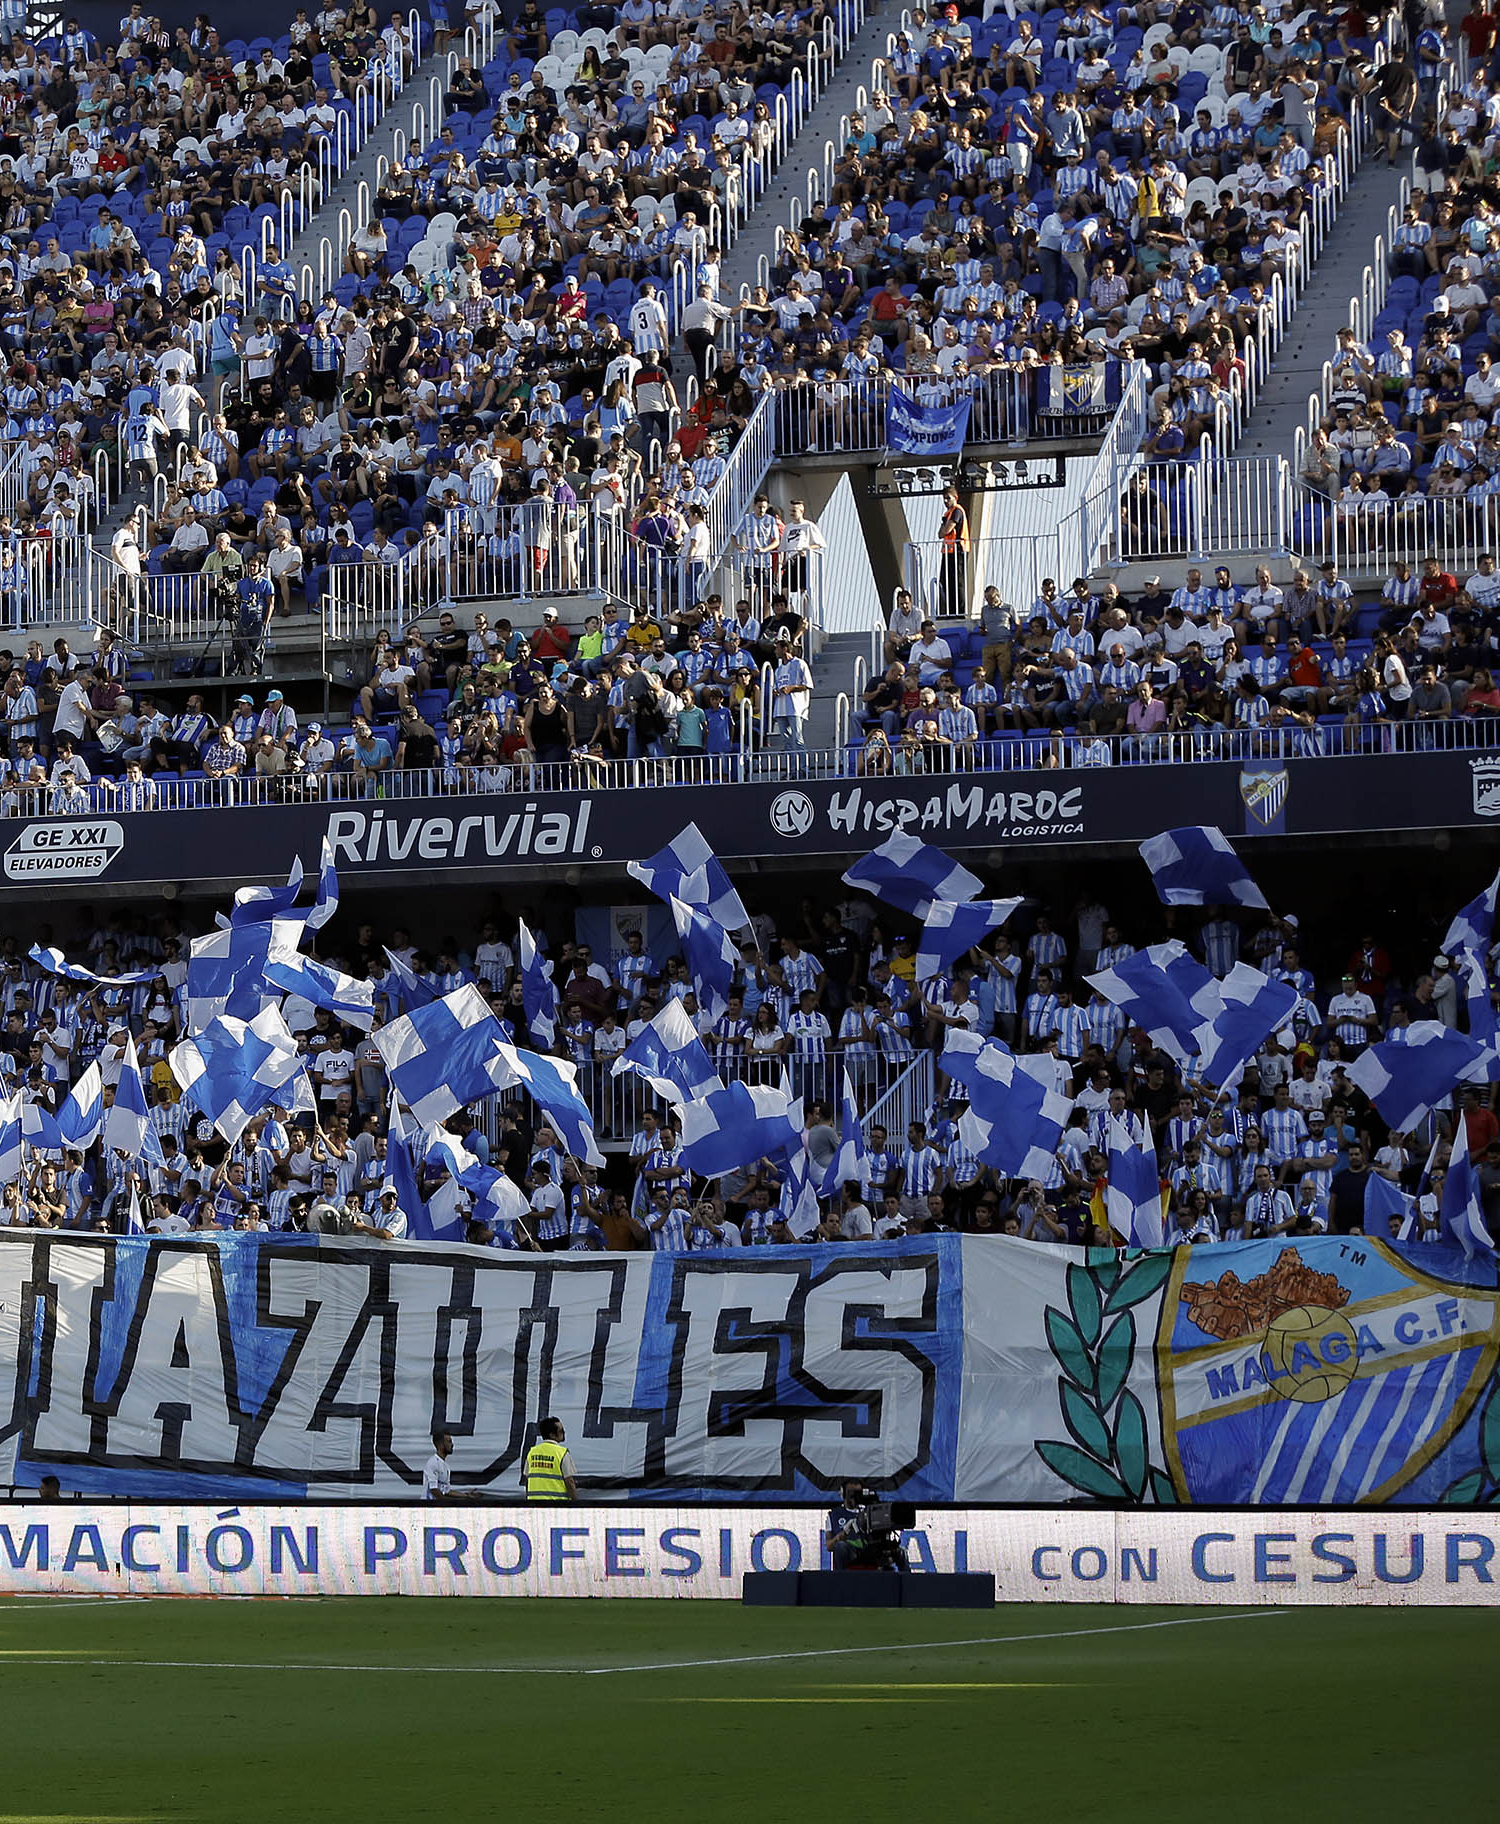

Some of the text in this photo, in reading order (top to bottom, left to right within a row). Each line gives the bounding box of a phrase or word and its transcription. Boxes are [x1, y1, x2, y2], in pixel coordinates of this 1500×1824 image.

[638, 311, 648, 329] 3
[616, 366, 631, 385] 11
[130, 424, 148, 441] 12
[33, 828, 108, 847] GE XXI
[326, 800, 592, 862] Rivervial
[1001, 823, 1084, 838] LOGISTICA
[10, 856, 103, 871] ELEVADORES
[326, 1060, 348, 1068] FILA
[1338, 1243, 1367, 1267] TM
[1204, 1297, 1468, 1400] MALAGA C.F.
[1031, 1545, 1158, 1582] CON
[1191, 1531, 1495, 1584] CESUR
